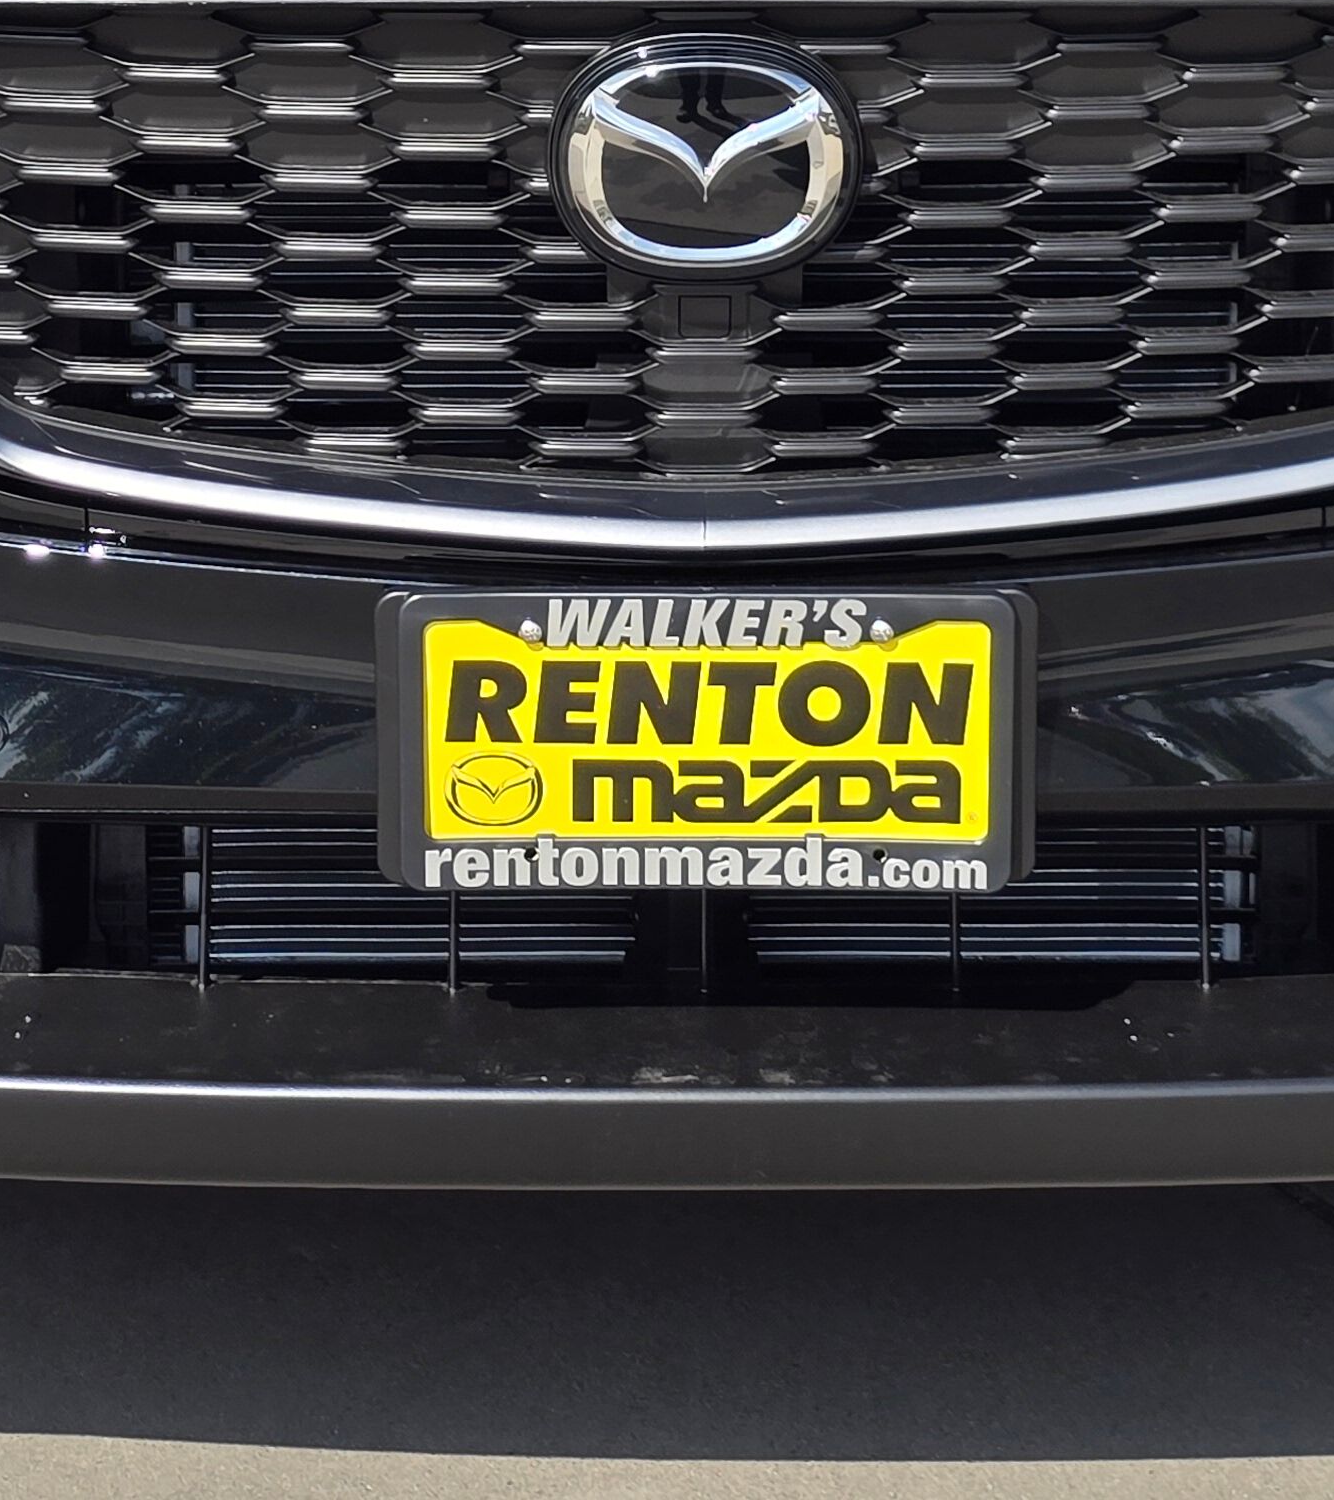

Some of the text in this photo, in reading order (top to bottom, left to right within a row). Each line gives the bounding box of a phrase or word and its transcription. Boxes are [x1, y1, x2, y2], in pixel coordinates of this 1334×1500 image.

[546, 599, 867, 648] WALKER'S
[445, 660, 974, 746] RENTON
[572, 759, 961, 823] mazda
[425, 838, 988, 889] rentonmazda.com
